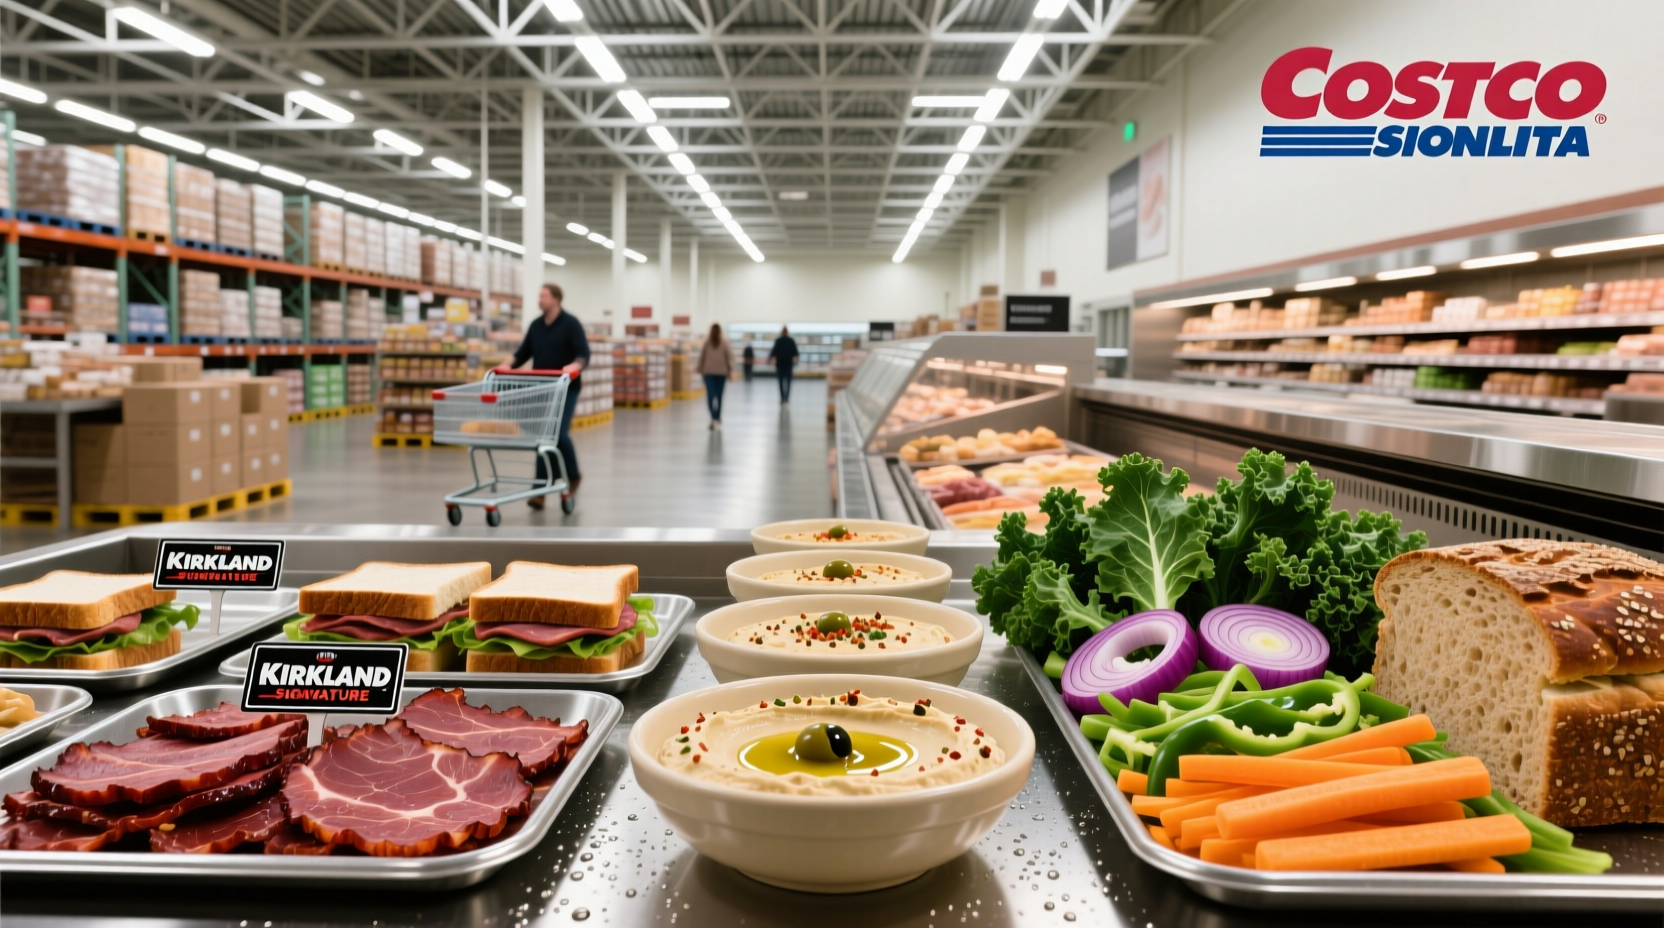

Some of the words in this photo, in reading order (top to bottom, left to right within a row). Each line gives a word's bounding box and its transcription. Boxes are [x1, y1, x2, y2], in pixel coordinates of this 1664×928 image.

[1261, 46, 1607, 120] COSTCO
[1373, 125, 1590, 157] SIONLITA
[166, 552, 273, 571] KIRKLAND
[258, 662, 392, 687] KIRKLAND
